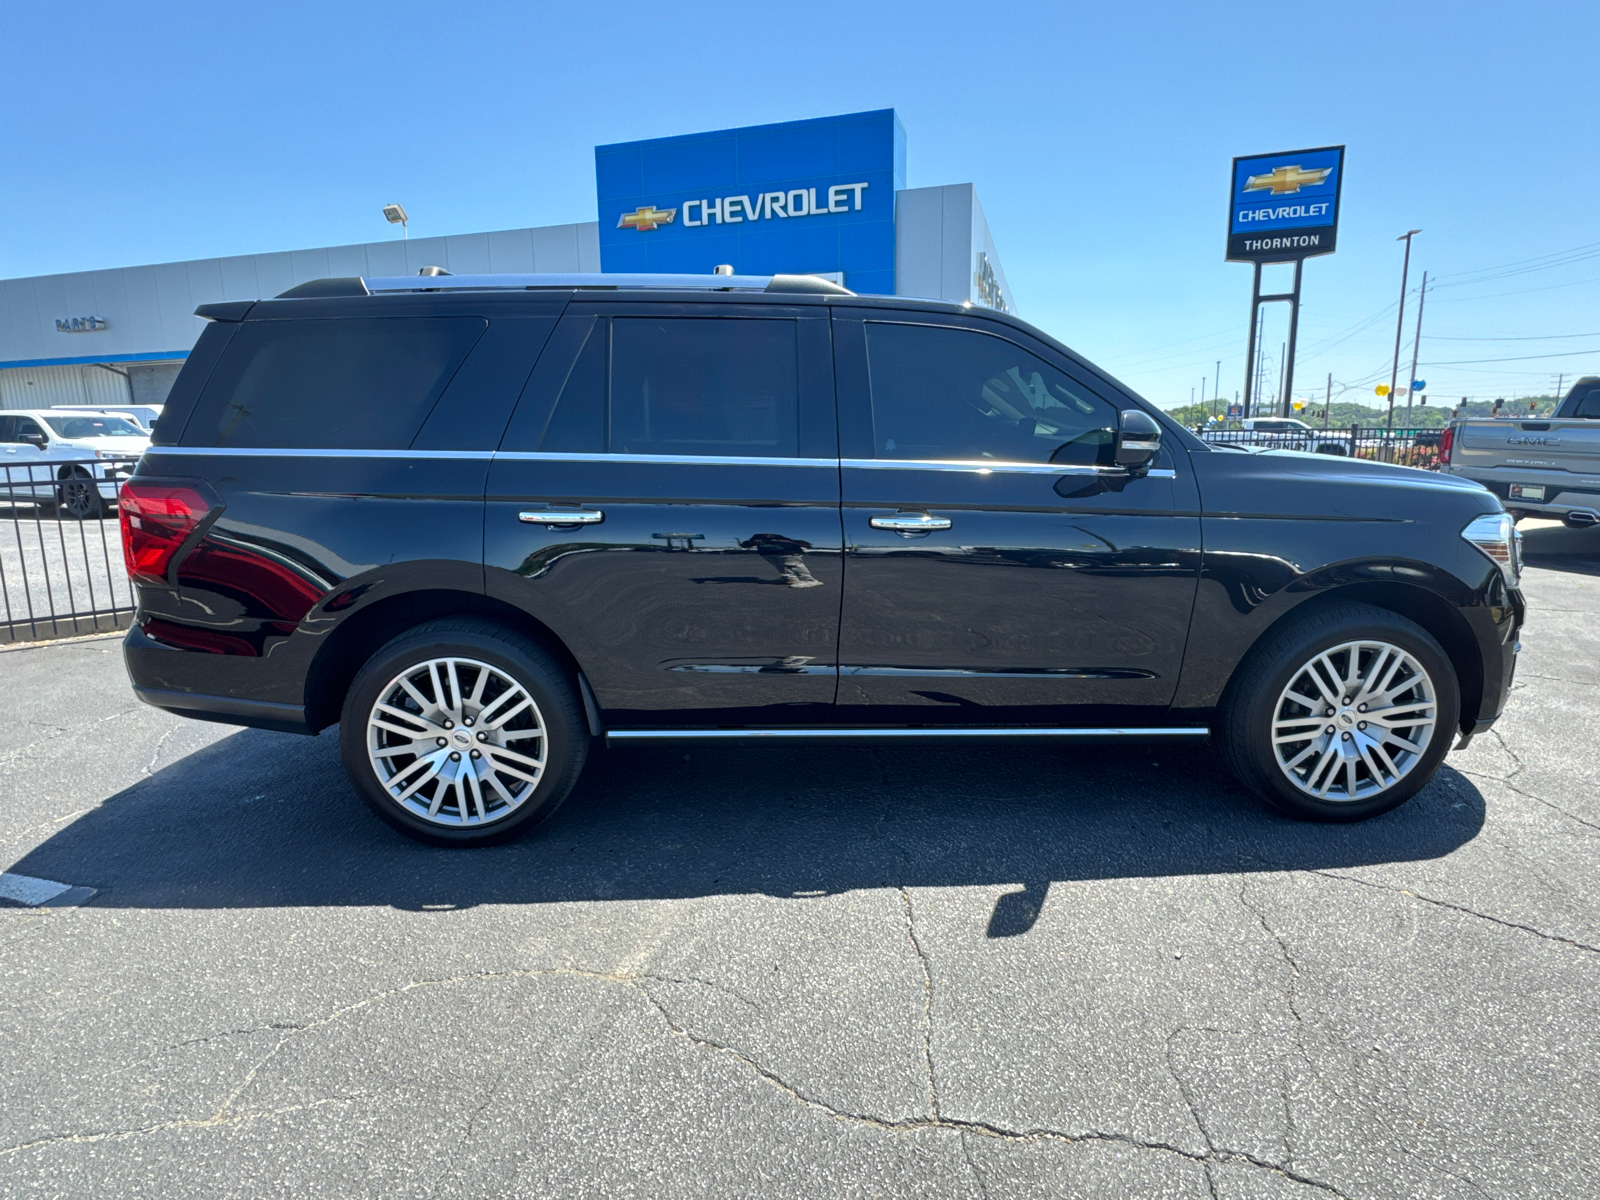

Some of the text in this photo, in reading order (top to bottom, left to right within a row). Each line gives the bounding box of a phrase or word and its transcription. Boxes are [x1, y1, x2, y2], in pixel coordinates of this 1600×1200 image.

[682, 182, 869, 227] CHEVROLET
[1238, 203, 1330, 223] CHEVROLET
[1244, 234, 1320, 251] THORNTON
[55, 316, 97, 332] PARTS
[1506, 436, 1562, 447] GMC
